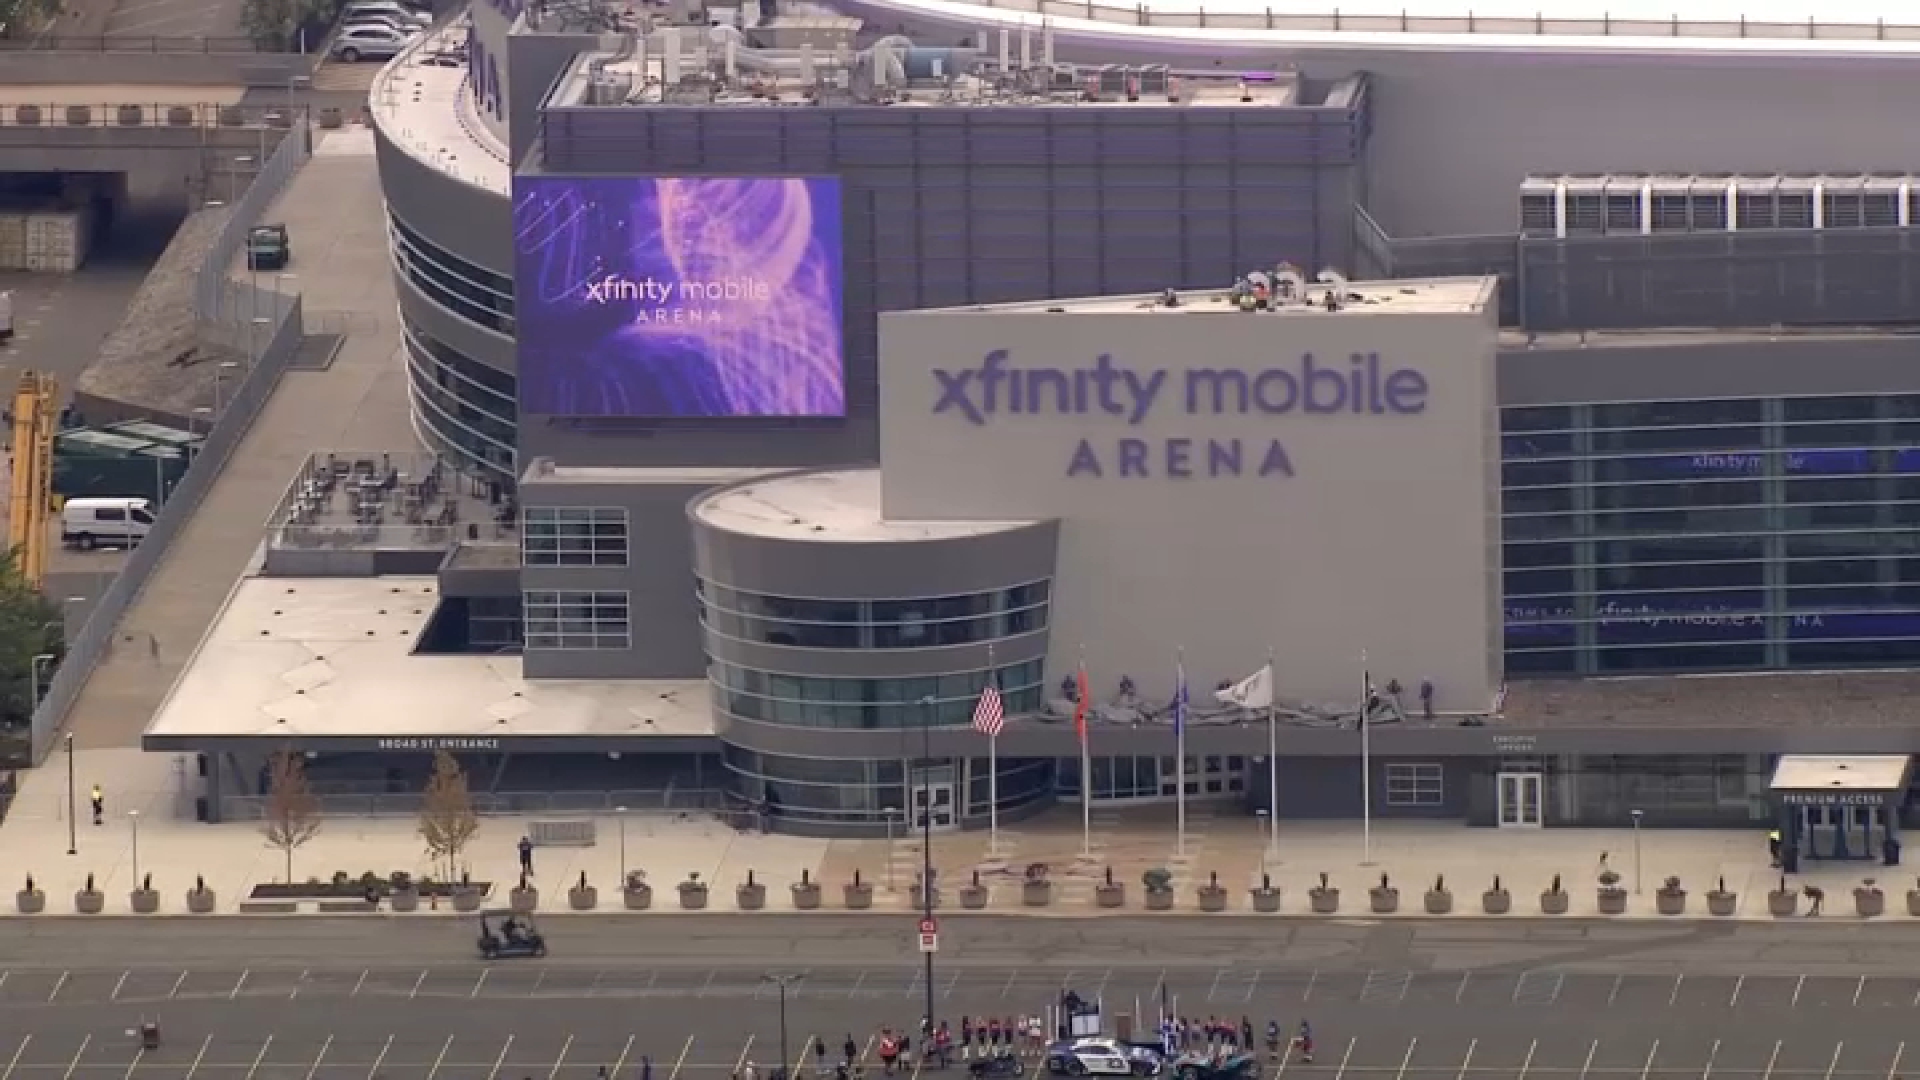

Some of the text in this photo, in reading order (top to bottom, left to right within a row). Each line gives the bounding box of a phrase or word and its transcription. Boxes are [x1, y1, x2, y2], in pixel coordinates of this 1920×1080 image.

[586, 274, 769, 304] xfinity mobile
[636, 308, 723, 323] ARENA
[932, 349, 1430, 425] xfinity mobile
[1066, 437, 1296, 478] ARENA
[1839, 793, 1884, 804] ACCESS
